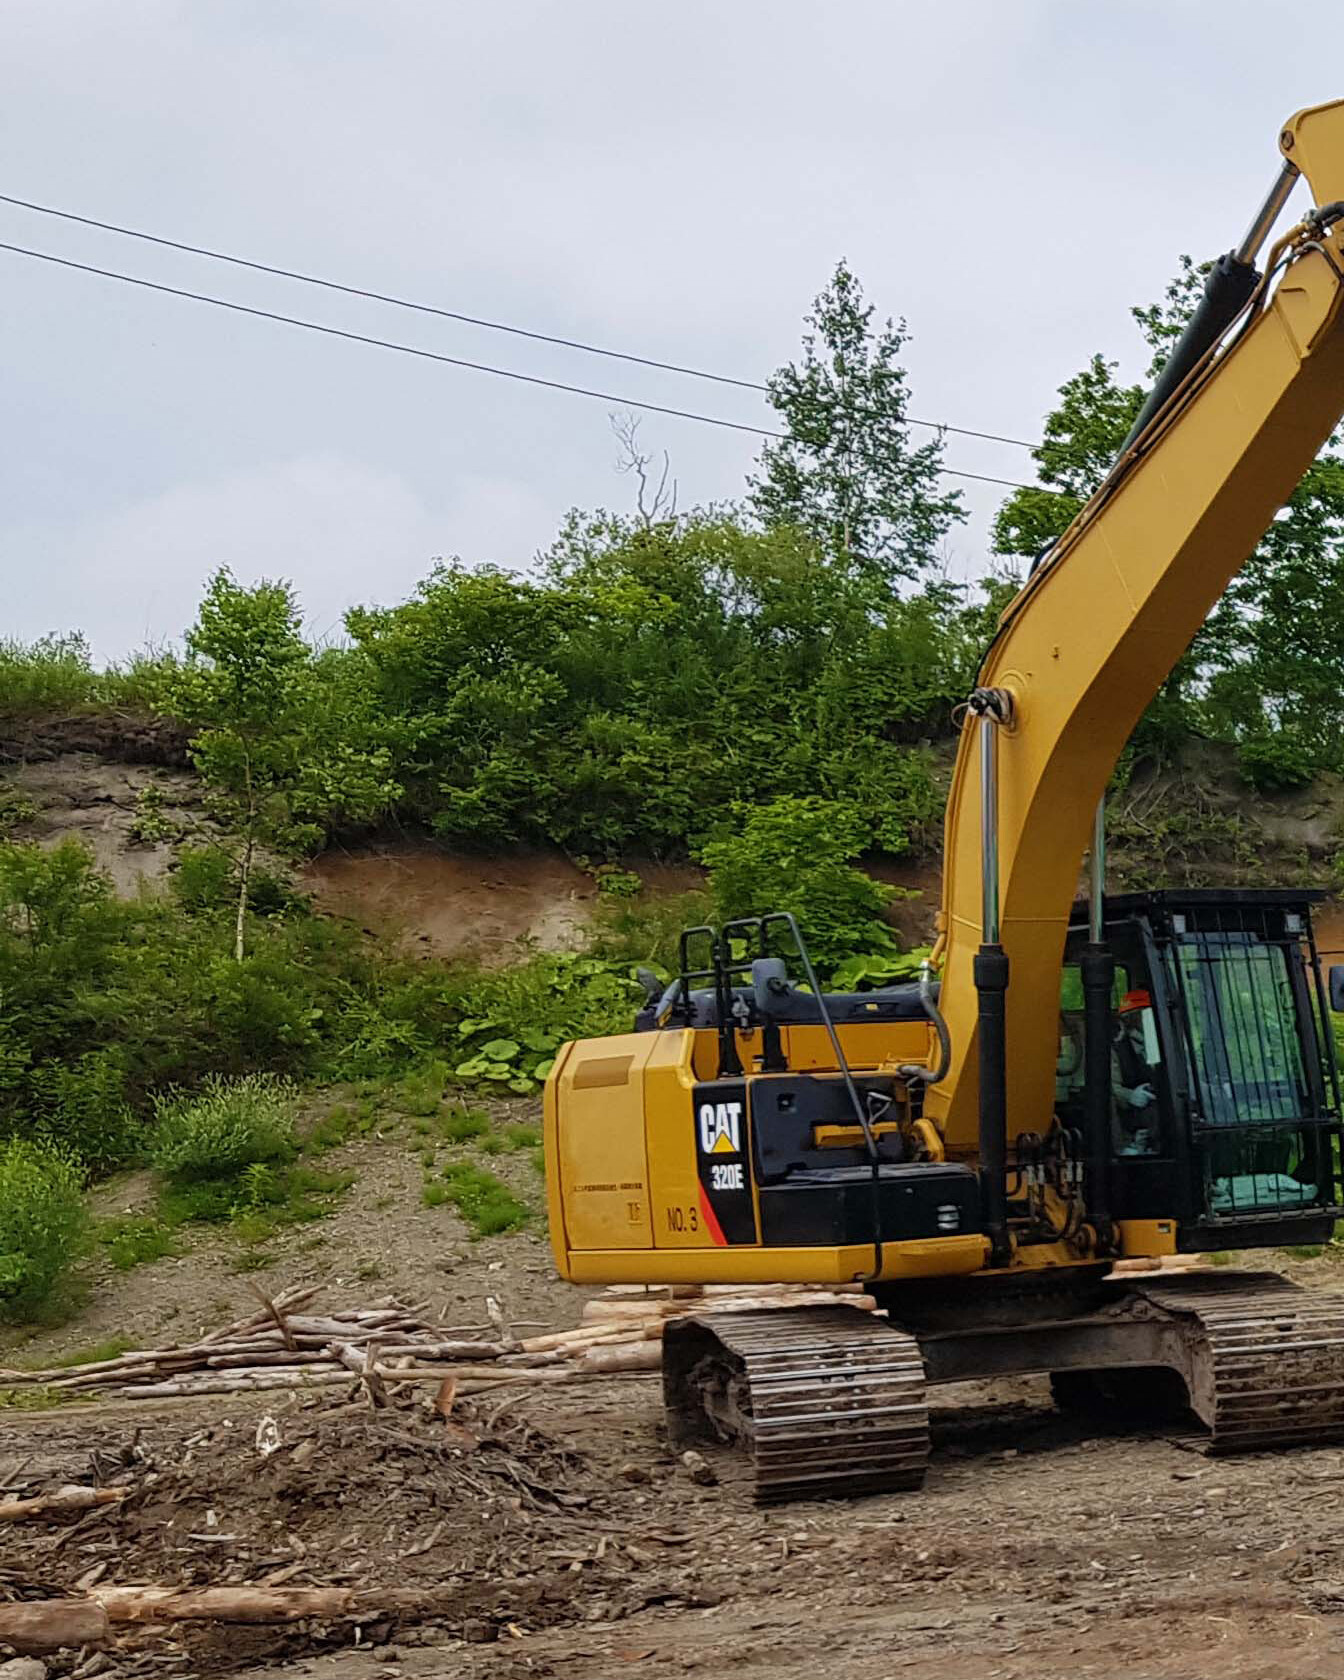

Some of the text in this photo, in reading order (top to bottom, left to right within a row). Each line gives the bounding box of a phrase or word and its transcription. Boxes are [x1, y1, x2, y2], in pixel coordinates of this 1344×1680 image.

[700, 1102, 742, 1154] CAT
[711, 1163, 744, 1190] 320E
[667, 1207, 687, 1231] NO.
[689, 1206, 698, 1231] 3
